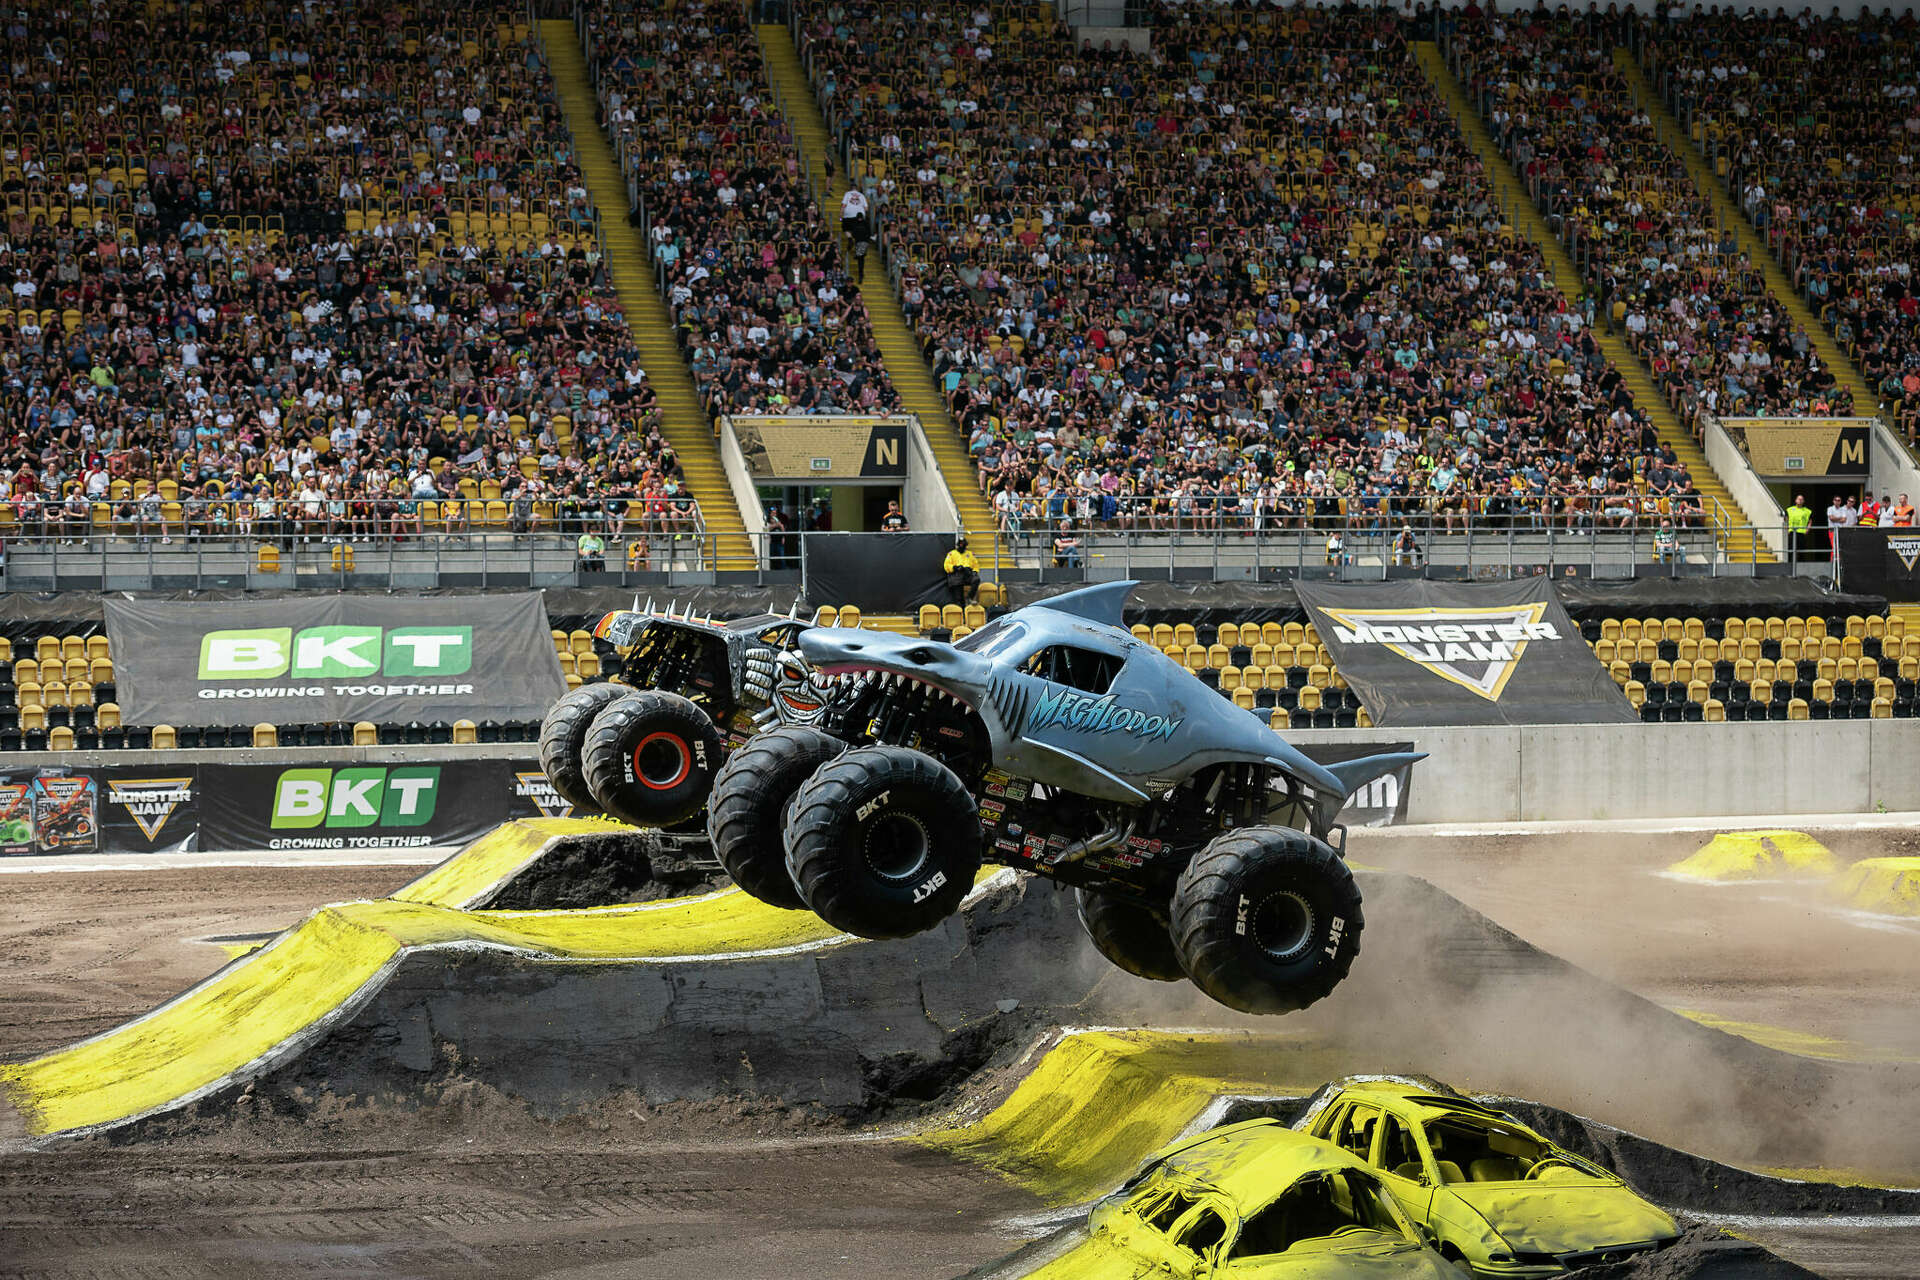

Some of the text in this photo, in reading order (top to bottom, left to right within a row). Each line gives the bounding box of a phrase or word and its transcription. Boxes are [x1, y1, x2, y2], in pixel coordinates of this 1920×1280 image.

[876, 438, 898, 465] N
[1841, 439, 1864, 465] M
[1888, 541, 1920, 549] MONST
[1331, 622, 1562, 644] MONSTER
[207, 634, 464, 671] BKT
[1413, 642, 1514, 662] JAM
[198, 683, 474, 699] GROWING TOGETHER
[1028, 682, 1185, 743] MEGALODON
[624, 752, 633, 784] BKT
[694, 740, 708, 771] BKT
[109, 789, 191, 804] MONSTER
[132, 802, 169, 815] JAM
[276, 778, 434, 817] BKT
[855, 790, 891, 822] BKT
[269, 836, 433, 850] GROWING TOGETHER
[912, 871, 948, 904] BKT
[1235, 894, 1250, 936] BKT
[1325, 916, 1345, 960] BKT
